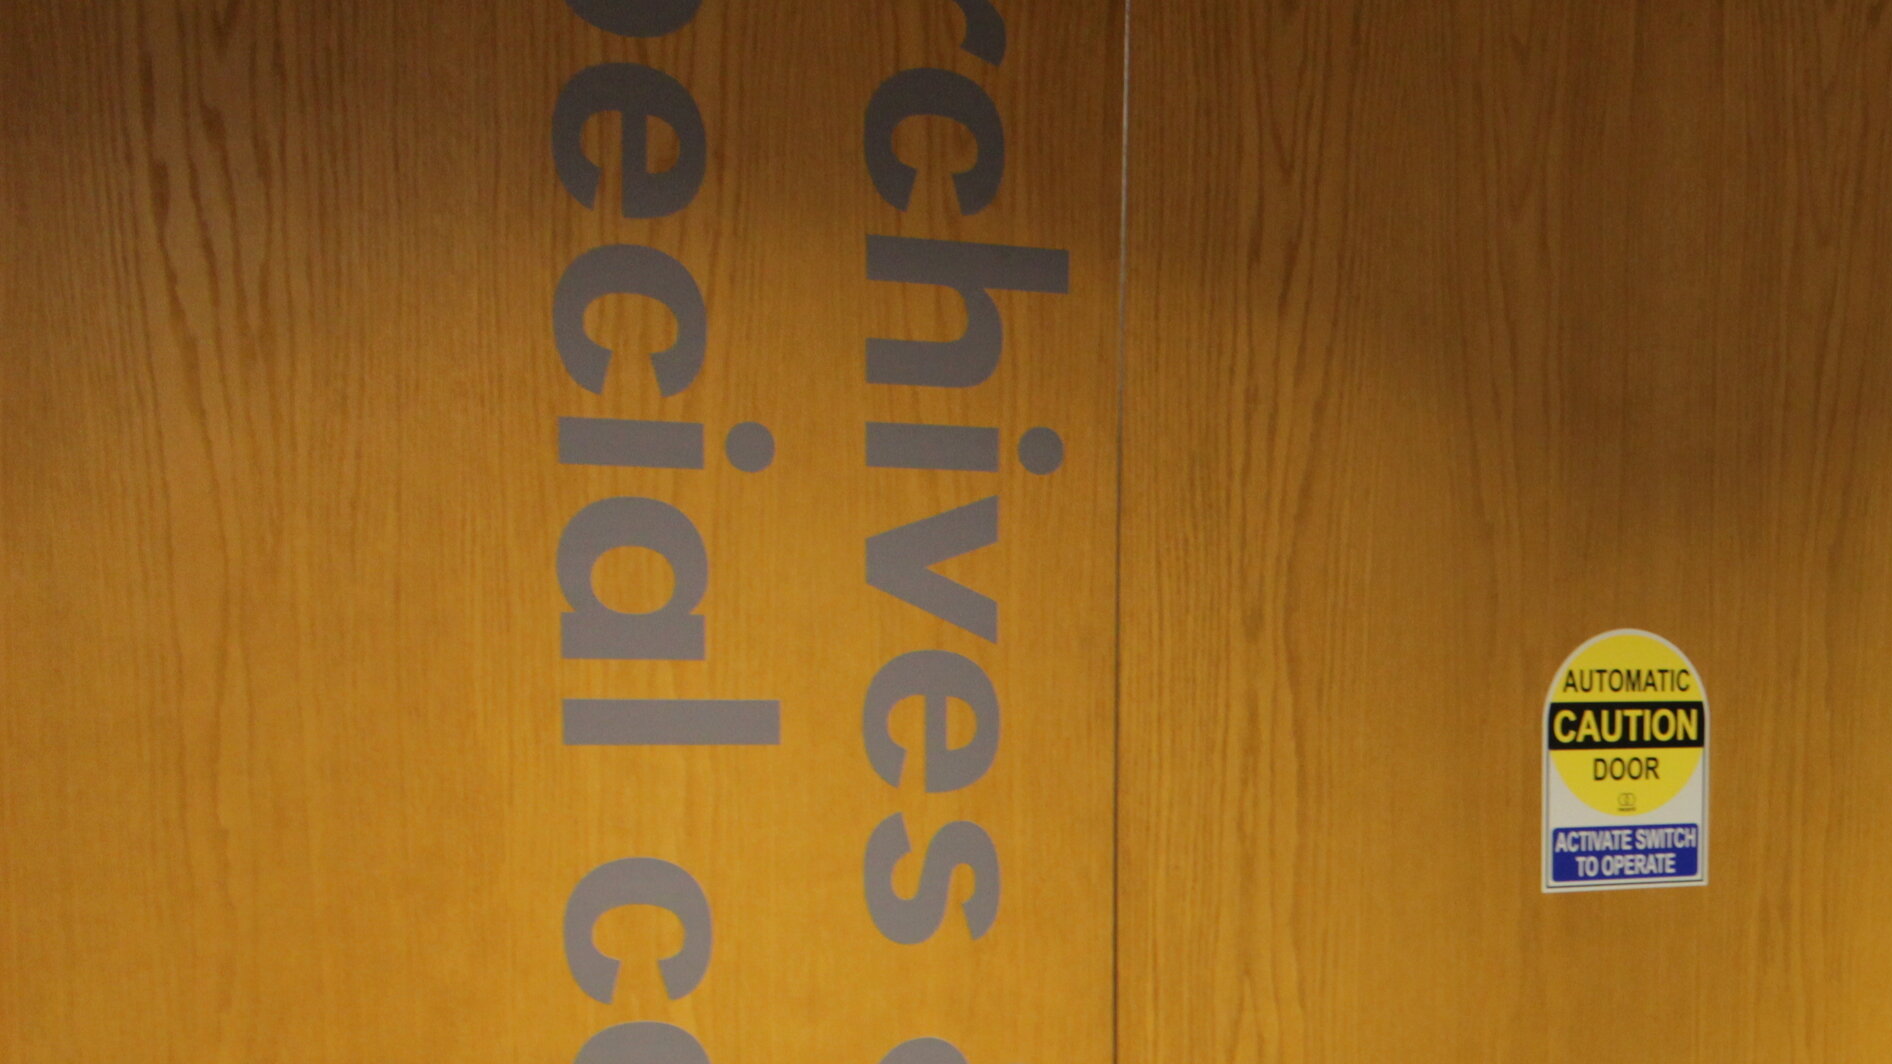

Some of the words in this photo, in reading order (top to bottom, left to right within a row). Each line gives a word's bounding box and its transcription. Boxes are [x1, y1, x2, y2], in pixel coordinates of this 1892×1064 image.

[551, 0, 782, 746] ecial
[1563, 669, 1690, 692] AUTOMATIC
[1553, 708, 1698, 743] CAUTION
[1593, 757, 1660, 781] DOOR
[1555, 829, 1632, 853] ACTIVATE
[1635, 827, 1697, 850] SWITCH
[1575, 855, 1599, 877] TO
[1601, 853, 1676, 876] OPERATE
